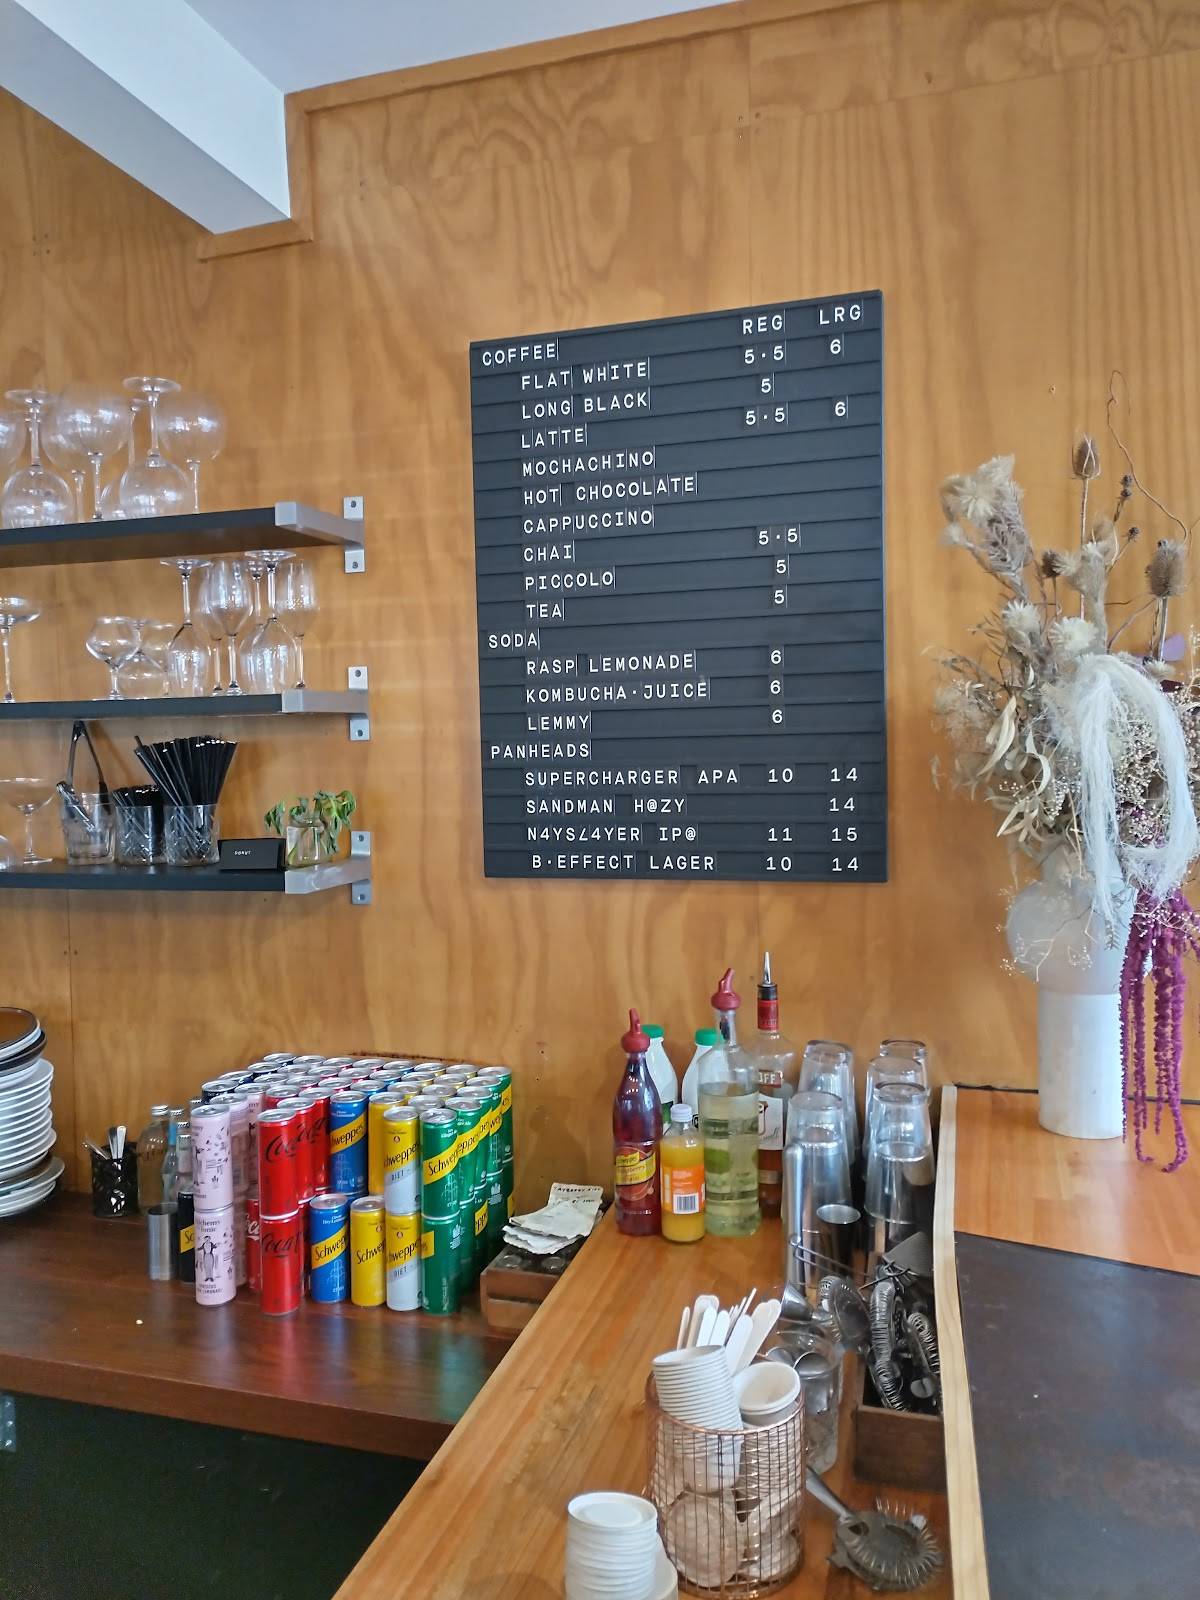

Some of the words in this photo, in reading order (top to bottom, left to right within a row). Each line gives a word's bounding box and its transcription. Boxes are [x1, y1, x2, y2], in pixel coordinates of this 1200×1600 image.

[482, 342, 556, 366] COFFEE
[742, 314, 783, 335] REG
[819, 304, 861, 325] LRG
[521, 370, 571, 391] FLAT
[582, 361, 647, 384] WHITE
[830, 338, 842, 355] 6
[522, 399, 571, 420] LONG
[584, 391, 647, 413] BLACK
[761, 377, 772, 394] 5
[521, 429, 585, 449] LATTE
[834, 401, 846, 417] 6
[522, 451, 654, 477] MOCHACHINO
[524, 488, 559, 505] HOT
[576, 476, 694, 503] CHOCOLATE
[523, 509, 653, 534] CAPPUCCINO
[523, 544, 572, 562] CHAI
[525, 571, 614, 591] PICCOLO
[776, 559, 787, 574] 5
[526, 603, 562, 619] TEA
[774, 589, 785, 605] 5
[488, 632, 538, 650] SODA
[526, 659, 575, 675] RASP
[589, 653, 694, 673] LEMONADE
[770, 649, 782, 665] 6
[770, 679, 781, 695] 6
[527, 715, 589, 731] LEMMY
[771, 709, 783, 724] 6
[491, 743, 590, 760] PANHEADS
[525, 769, 678, 786] SUPERCHARGER
[697, 768, 738, 784] APA
[768, 767, 793, 783] 10
[830, 767, 858, 782] 14
[526, 799, 614, 814] SANDMAN
[634, 798, 685, 813] H@ZY
[829, 797, 855, 812] 14
[659, 826, 696, 842] IP@
[767, 827, 793, 842] 11
[831, 827, 858, 842] 15
[649, 855, 714, 871] LAGER
[766, 856, 792, 872] 10
[832, 857, 859, 872] 14
[428, 1145, 457, 1176] Schwep
[314, 1235, 346, 1261] Schwep
